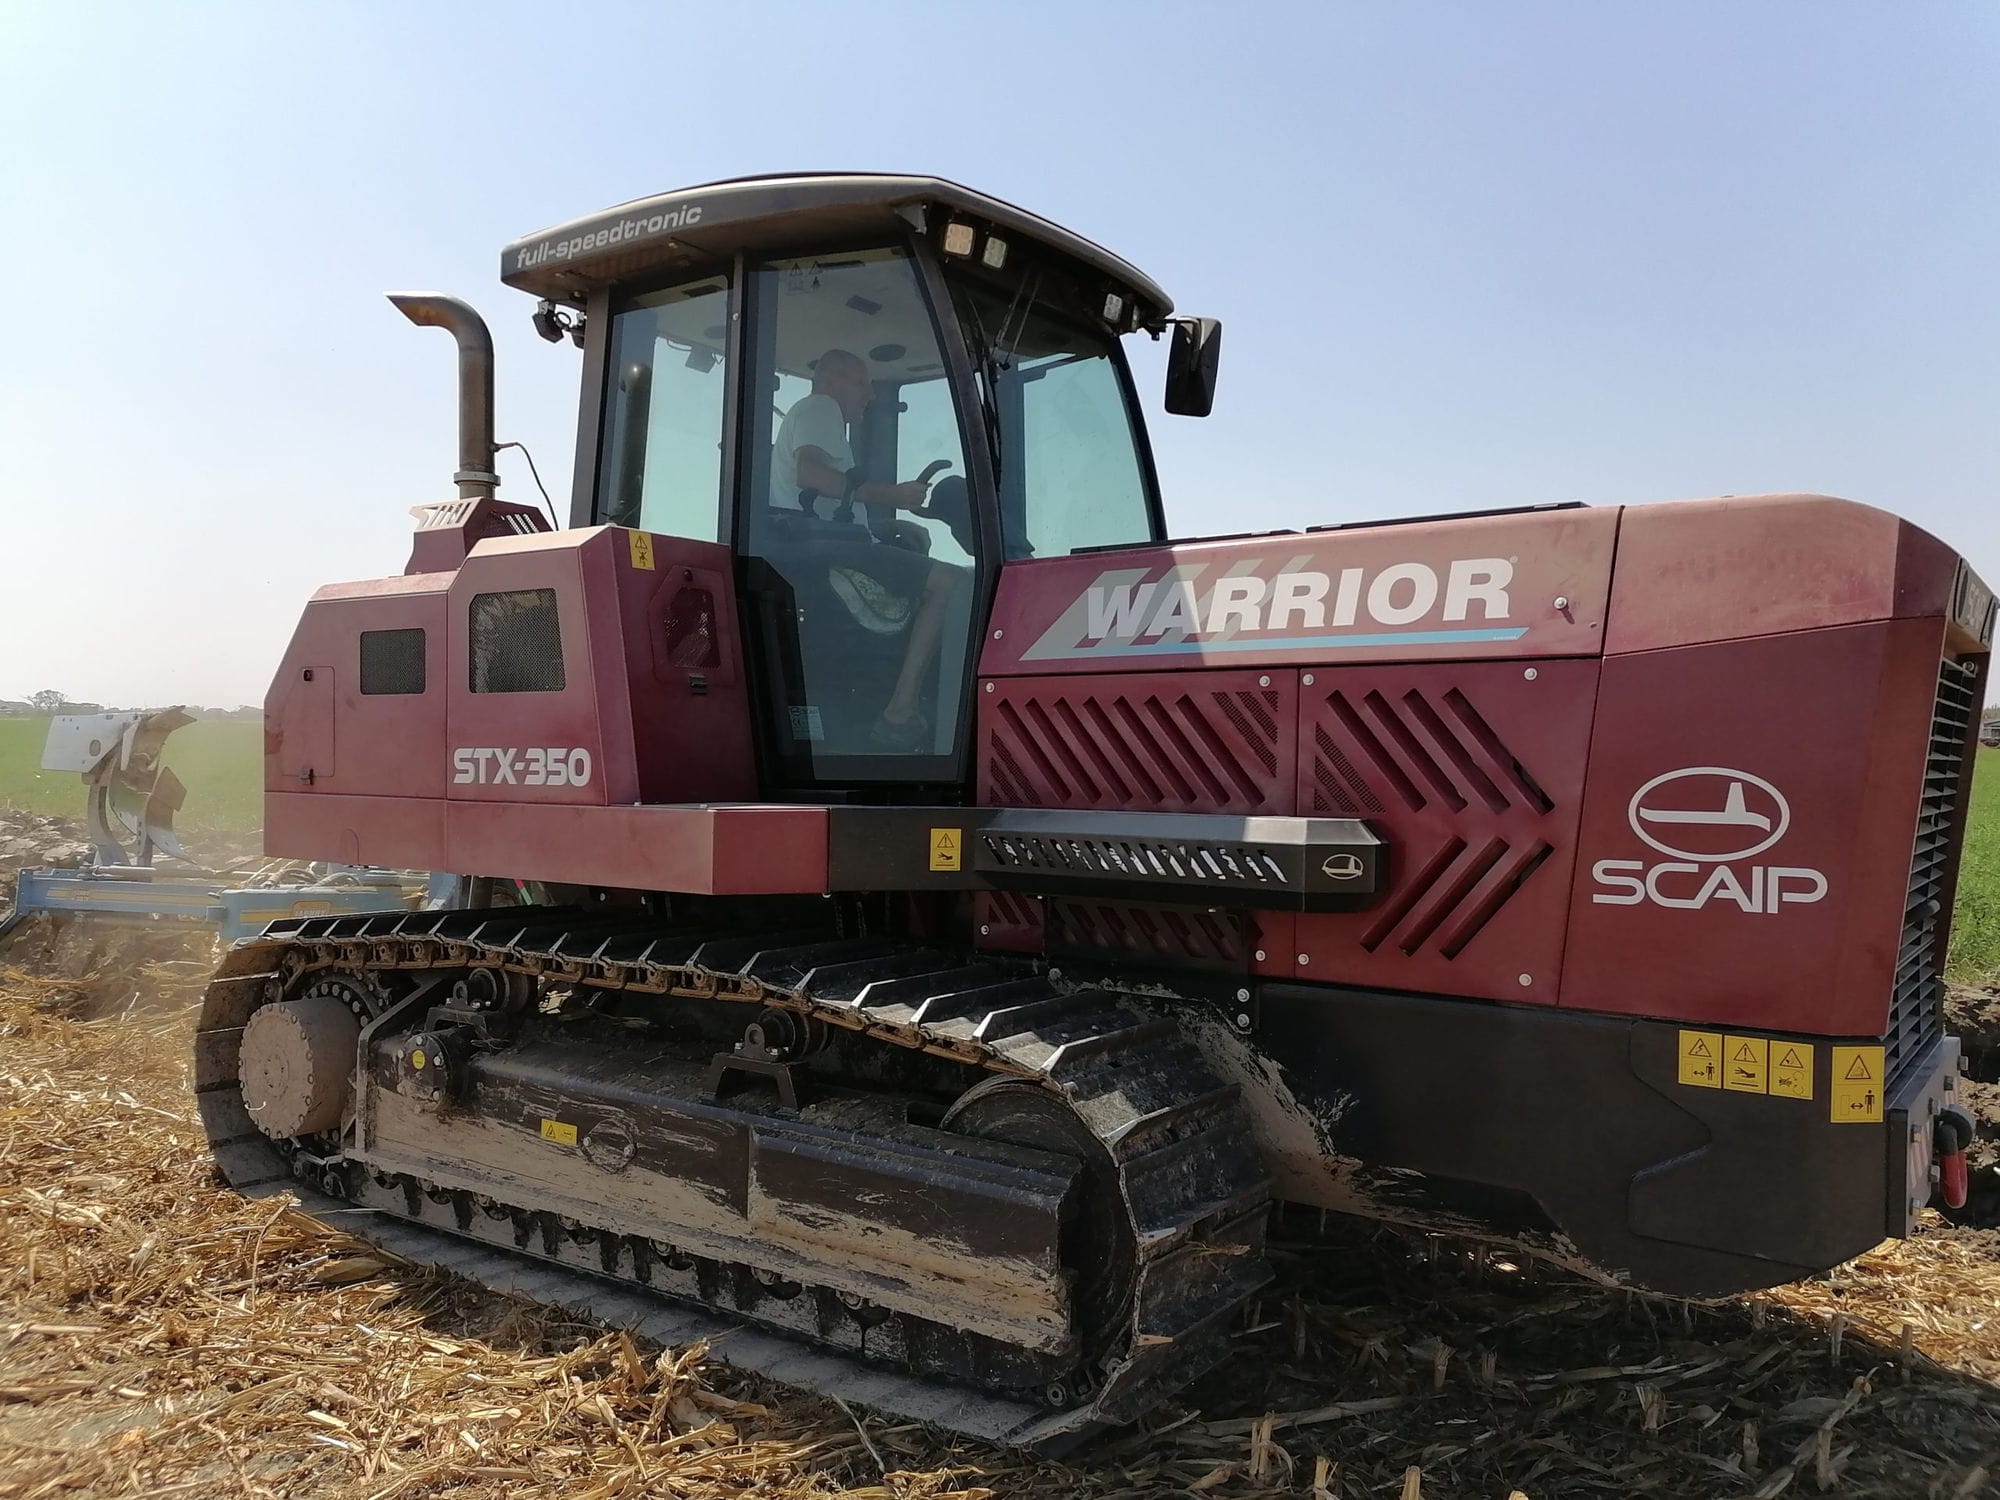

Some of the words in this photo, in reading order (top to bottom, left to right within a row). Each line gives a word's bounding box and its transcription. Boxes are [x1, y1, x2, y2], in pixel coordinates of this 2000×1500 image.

[516, 205, 702, 268] full-speedtronic
[1087, 557, 1512, 640] WARRIOR
[453, 747, 592, 787] STX-350
[1592, 859, 1828, 914] SCAIP
